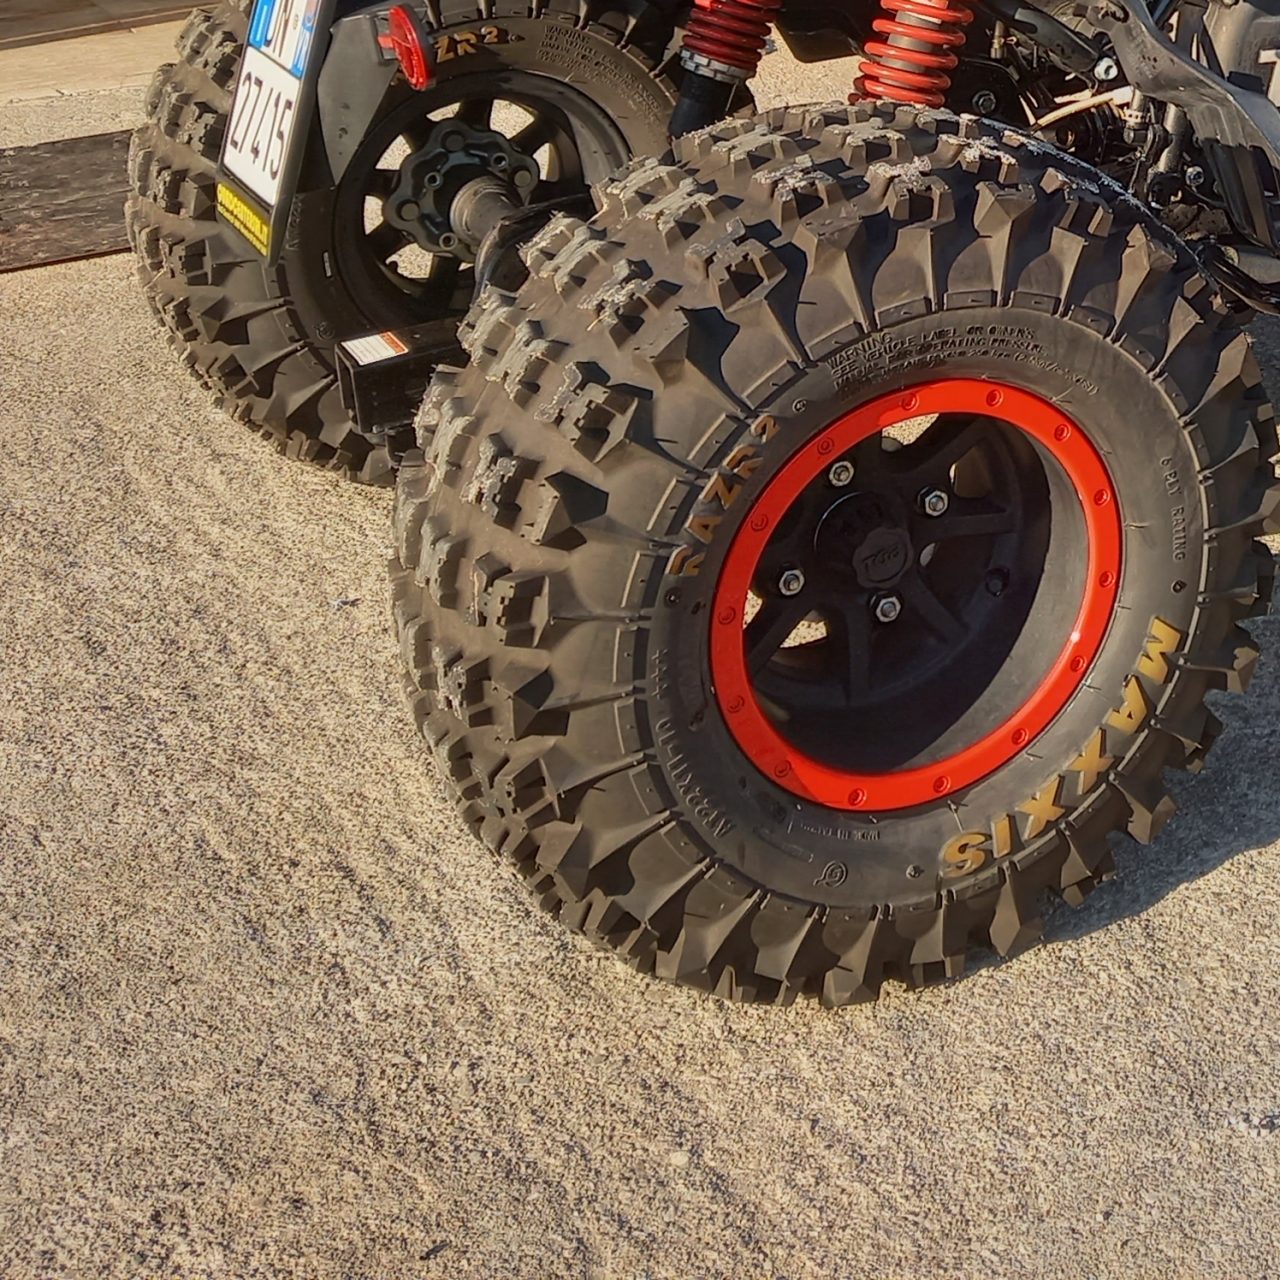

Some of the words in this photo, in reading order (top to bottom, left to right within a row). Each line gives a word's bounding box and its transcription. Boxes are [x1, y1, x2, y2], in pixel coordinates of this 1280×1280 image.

[434, 25, 499, 64] ZR2
[230, 72, 293, 181] 27415
[825, 331, 893, 370] WARNING
[1163, 469, 1183, 496] PLY
[1170, 504, 1187, 562] RATING
[938, 615, 1182, 878] MAXXIS
